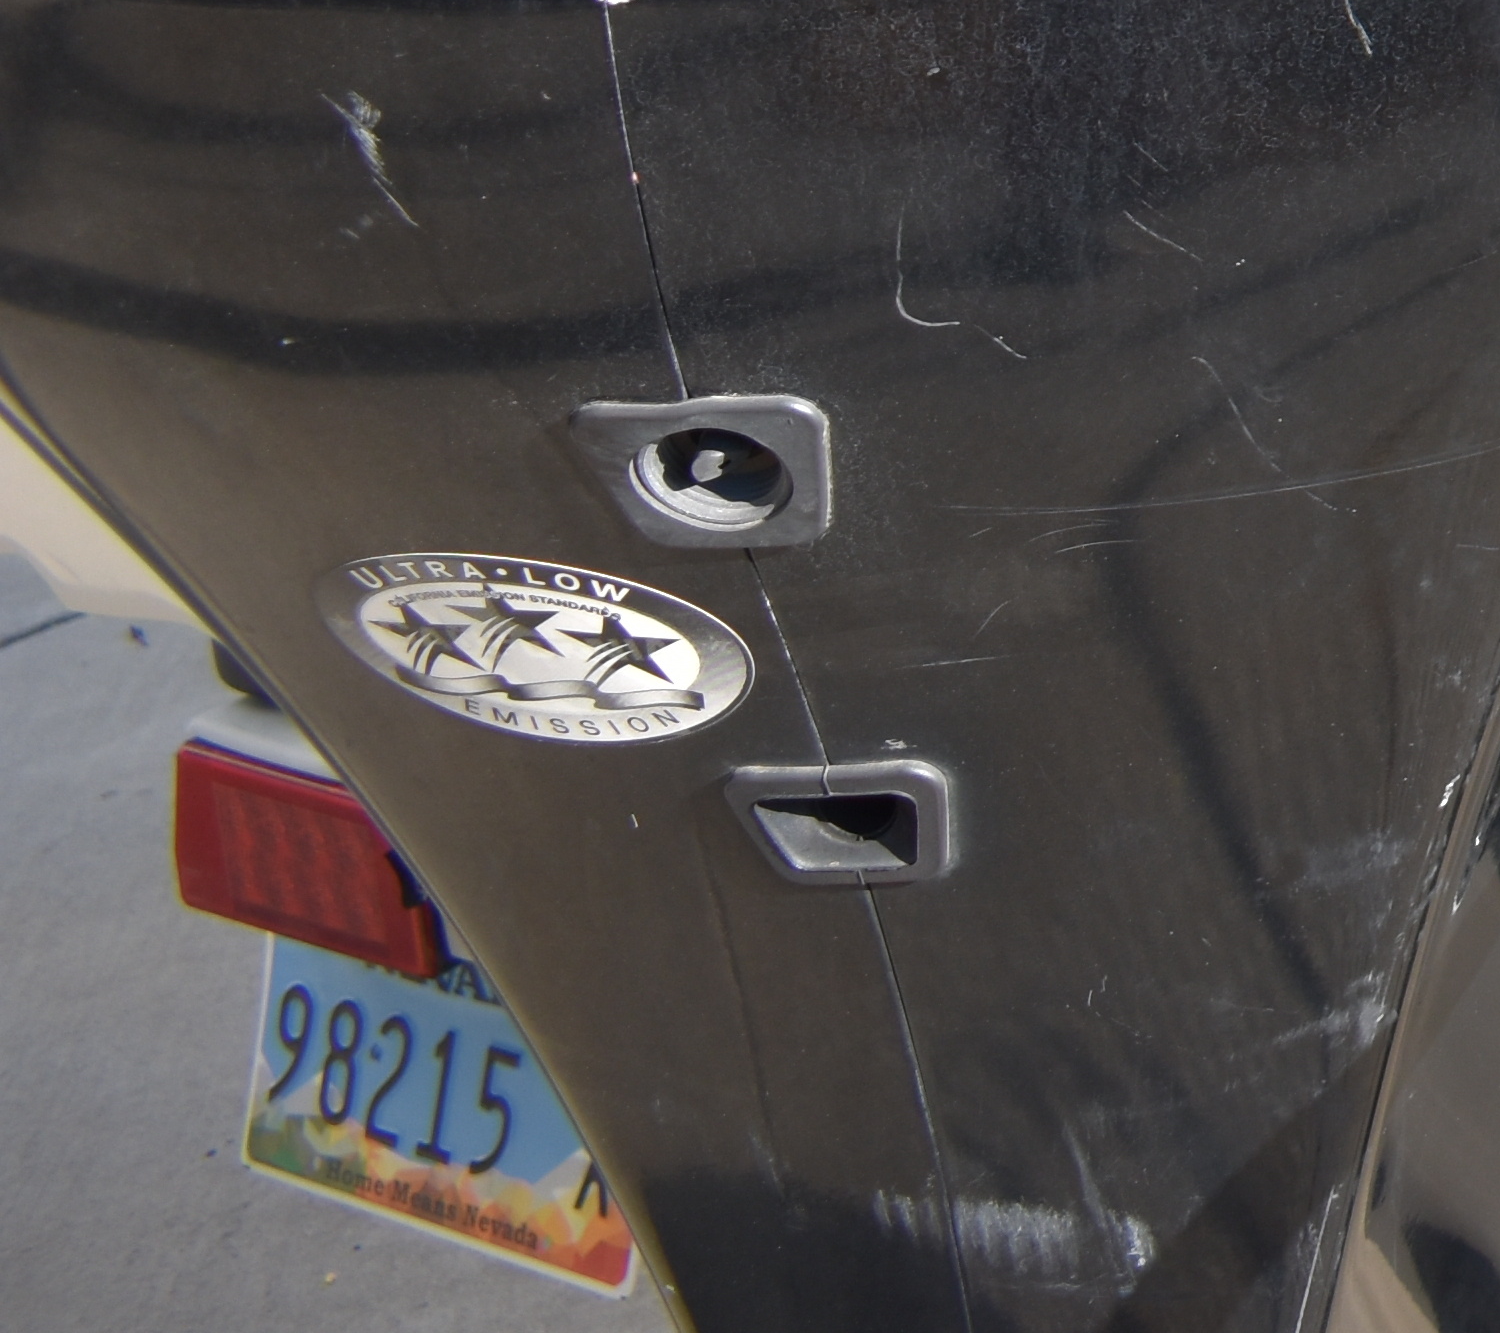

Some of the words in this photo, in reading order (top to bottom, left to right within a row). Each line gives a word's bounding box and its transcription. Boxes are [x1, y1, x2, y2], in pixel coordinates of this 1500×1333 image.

[349, 559, 487, 590] ULTRA
[520, 566, 633, 603] LOW
[463, 697, 681, 737] EMISSION
[324, 1156, 386, 1195] Home
[391, 1178, 458, 1221] Means
[462, 1203, 540, 1251] Nevada
